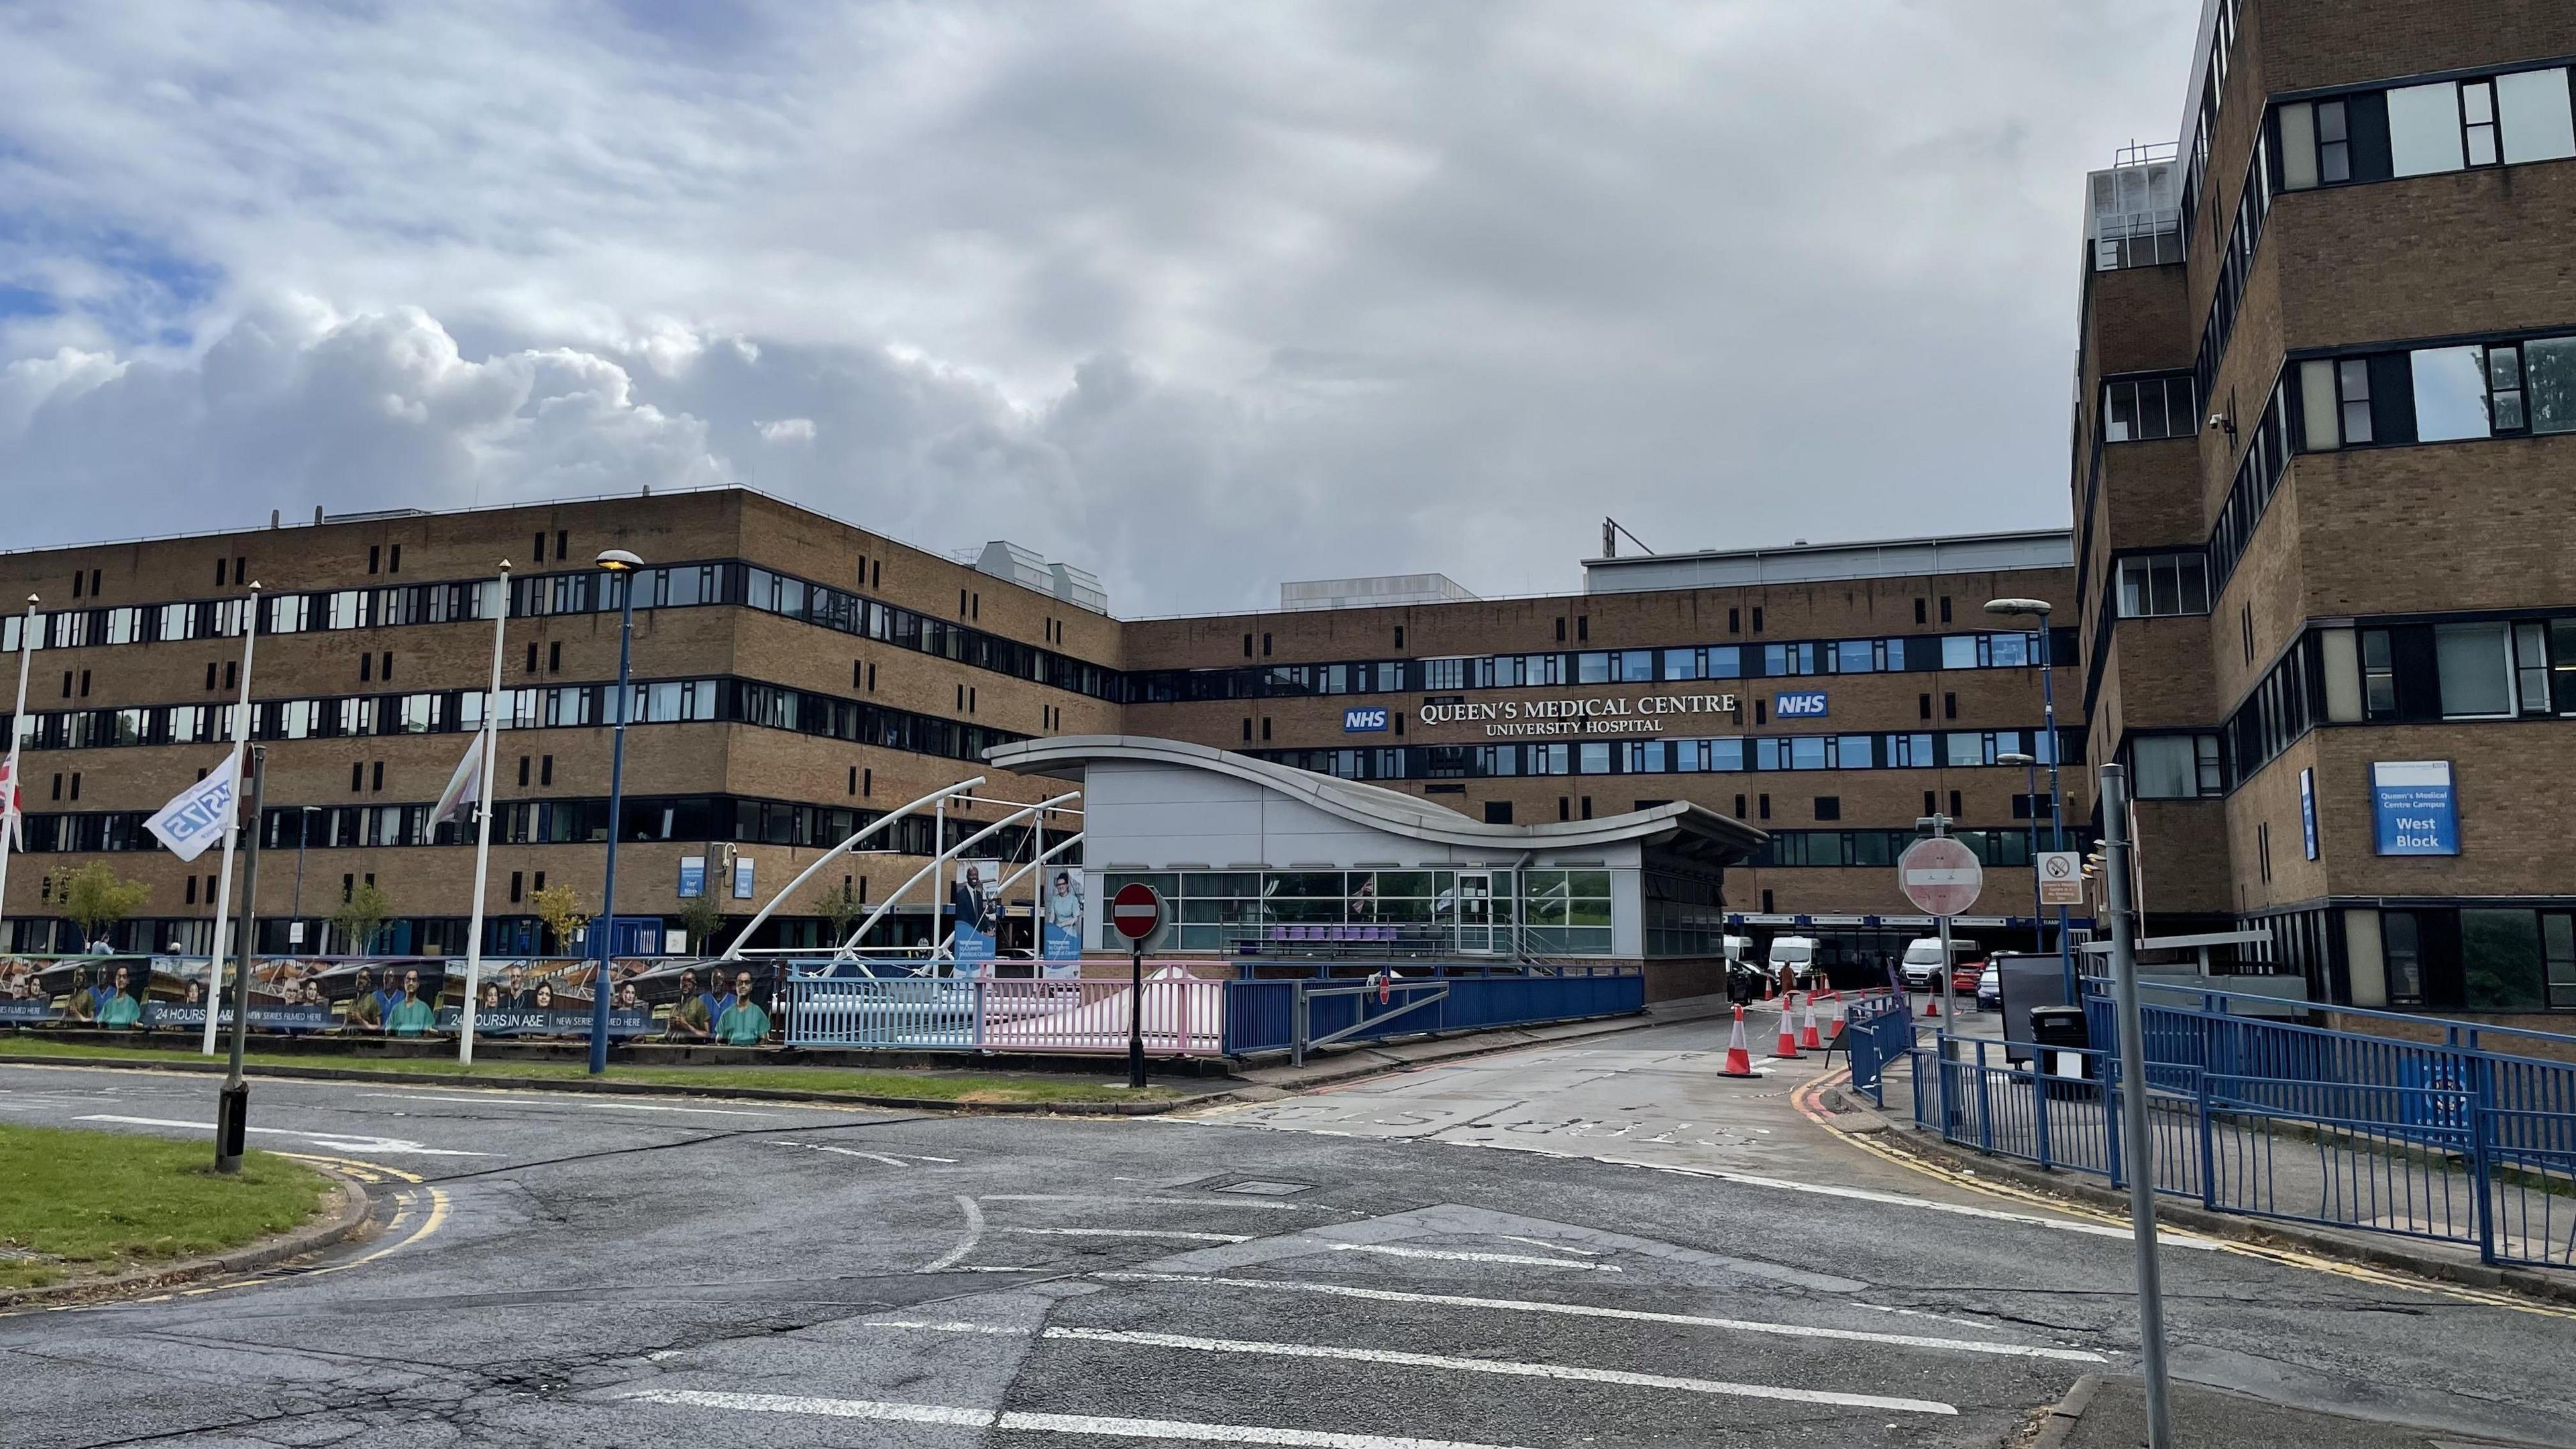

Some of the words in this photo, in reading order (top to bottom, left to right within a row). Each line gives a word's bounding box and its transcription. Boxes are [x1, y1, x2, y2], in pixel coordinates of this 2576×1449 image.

[1419, 702, 1517, 725] QUEEN’S
[1524, 698, 1631, 719] MEDICAL
[1638, 694, 1735, 714] CENTRE
[1778, 696, 1825, 714] NHS
[1346, 711, 1385, 727] NHS
[1486, 722, 1581, 737] UNIVERSITY
[1586, 719, 1663, 733] HOSPITAL
[2413, 801, 2445, 809] Campus
[2396, 818, 2436, 830] West
[2396, 835, 2439, 847] Block
[156, 1008, 167, 1020] 24
[170, 1008, 206, 1021] HOURS
[246, 1011, 262, 1020] NEW
[262, 1012, 282, 1020] SERIES
[283, 1012, 305, 1020] FILMED
[307, 1013, 322, 1021] HERE
[450, 1014, 463, 1026] 24
[474, 1014, 506, 1027] OURS
[508, 1014, 520, 1026] IN
[521, 1014, 544, 1027] A&E
[555, 1017, 571, 1025] NEW
[623, 1018, 641, 1026] HERE
